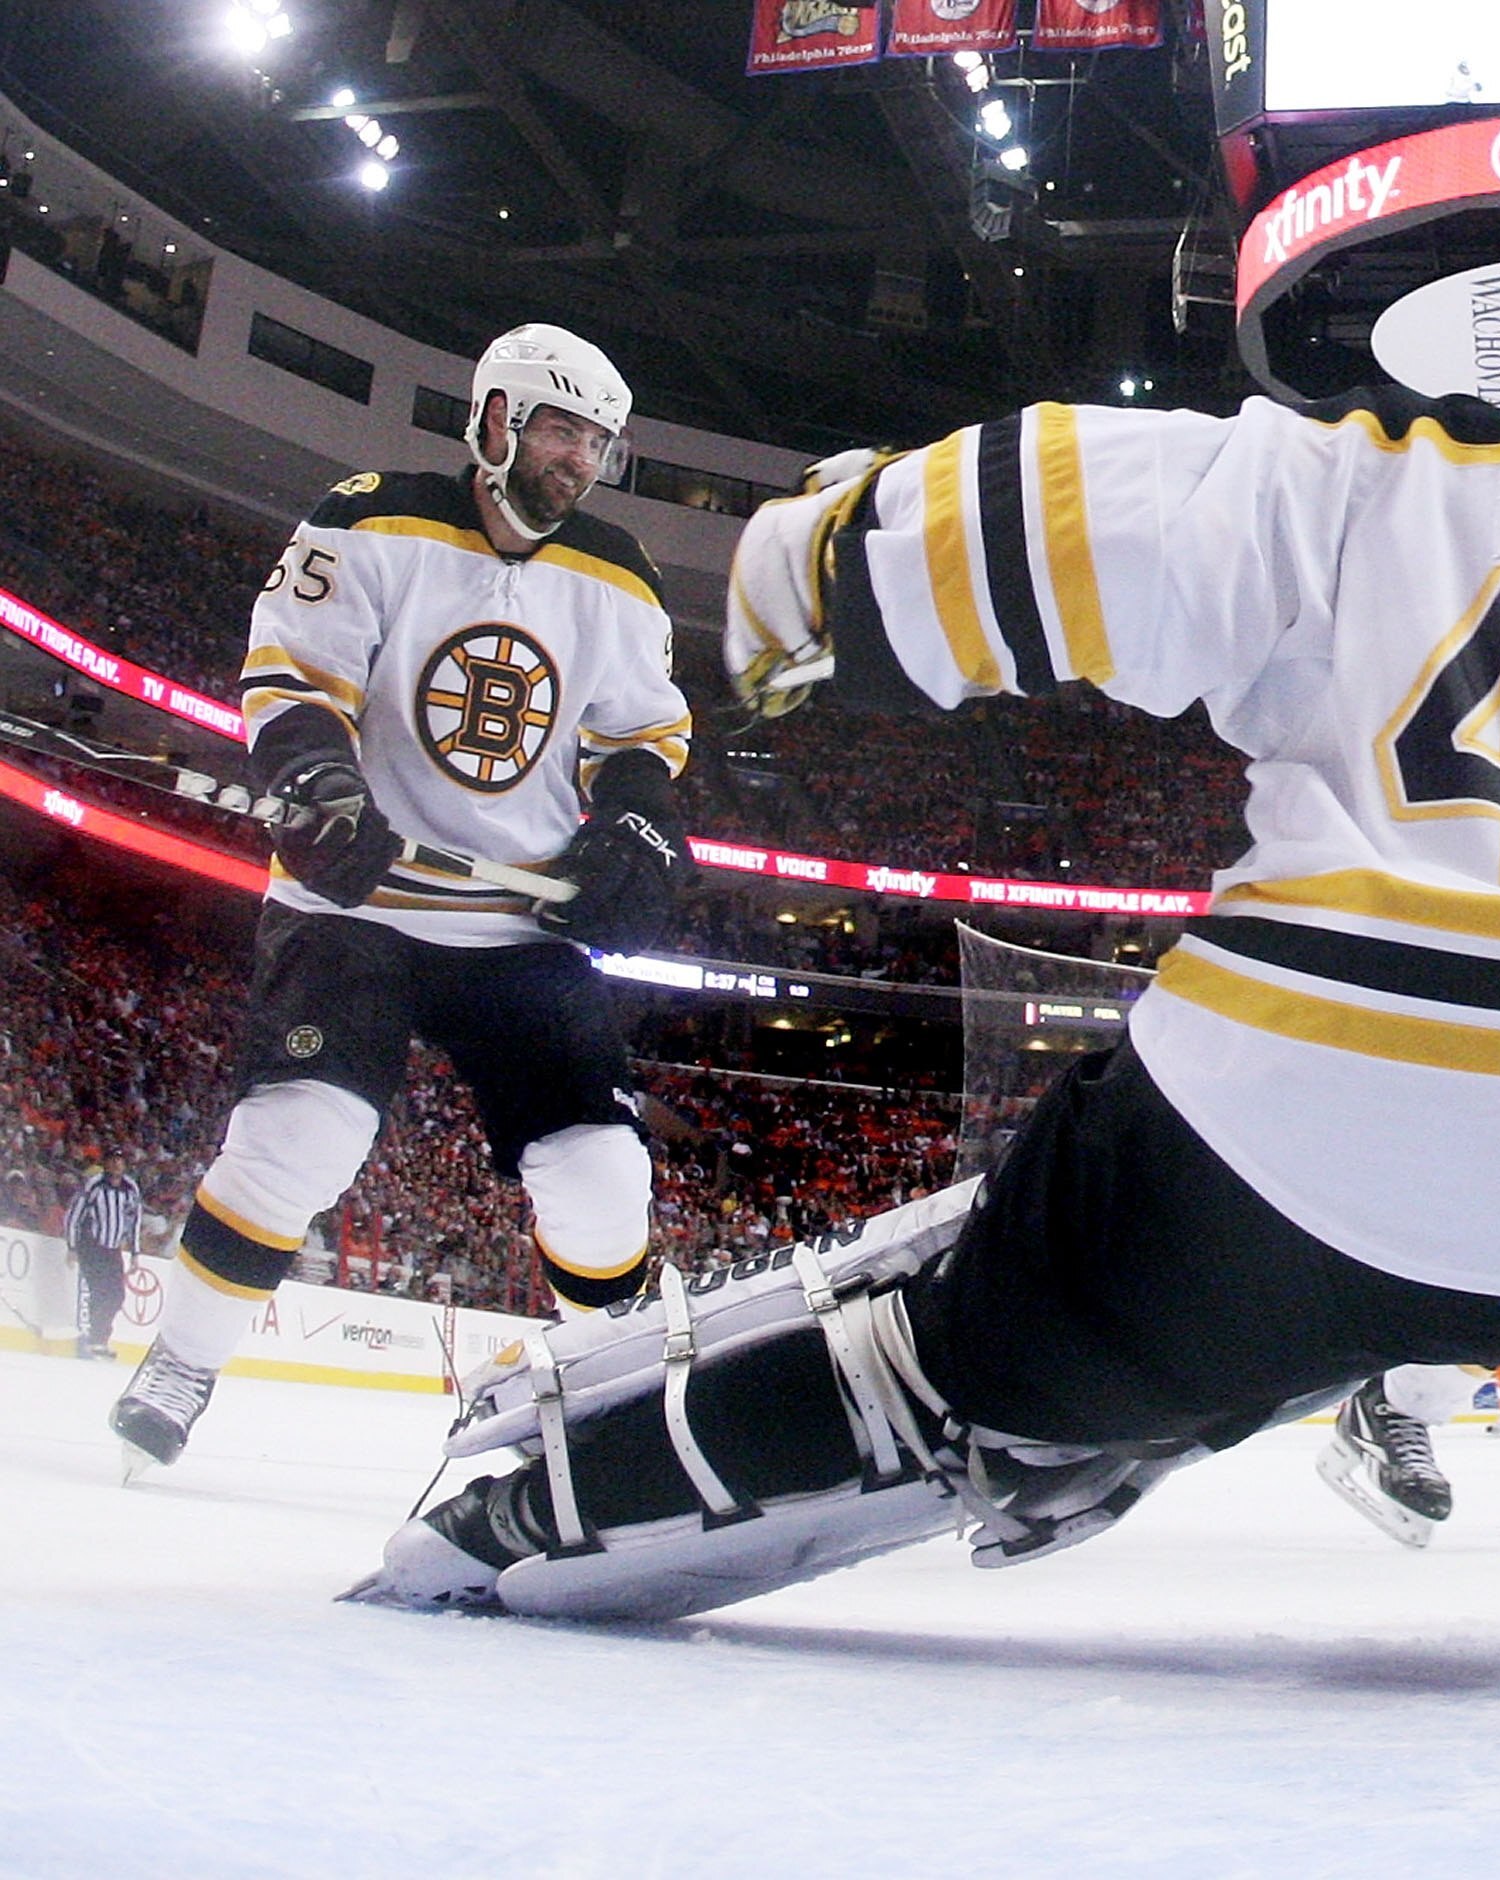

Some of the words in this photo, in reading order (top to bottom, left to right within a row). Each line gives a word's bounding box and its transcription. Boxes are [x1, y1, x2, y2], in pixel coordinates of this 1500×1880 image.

[895, 32, 972, 44] Philadelphia
[975, 30, 1009, 42] 76ers
[754, 49, 835, 64] Philadelphia
[837, 43, 873, 56] 76ers
[1263, 156, 1401, 263] xfinity
[0, 594, 41, 636] FINITY
[40, 622, 84, 663] TRIPLE
[142, 676, 164, 701] TV
[169, 690, 243, 735] INTERNET
[776, 855, 827, 880] VOICE
[866, 867, 936, 898] xfinity
[969, 881, 1005, 900] THE
[1007, 887, 1077, 906] XFINITY
[1078, 891, 1139, 910] TRIPLE
[1140, 895, 1193, 912] PLAY.
[342, 1319, 393, 1350] verizon
